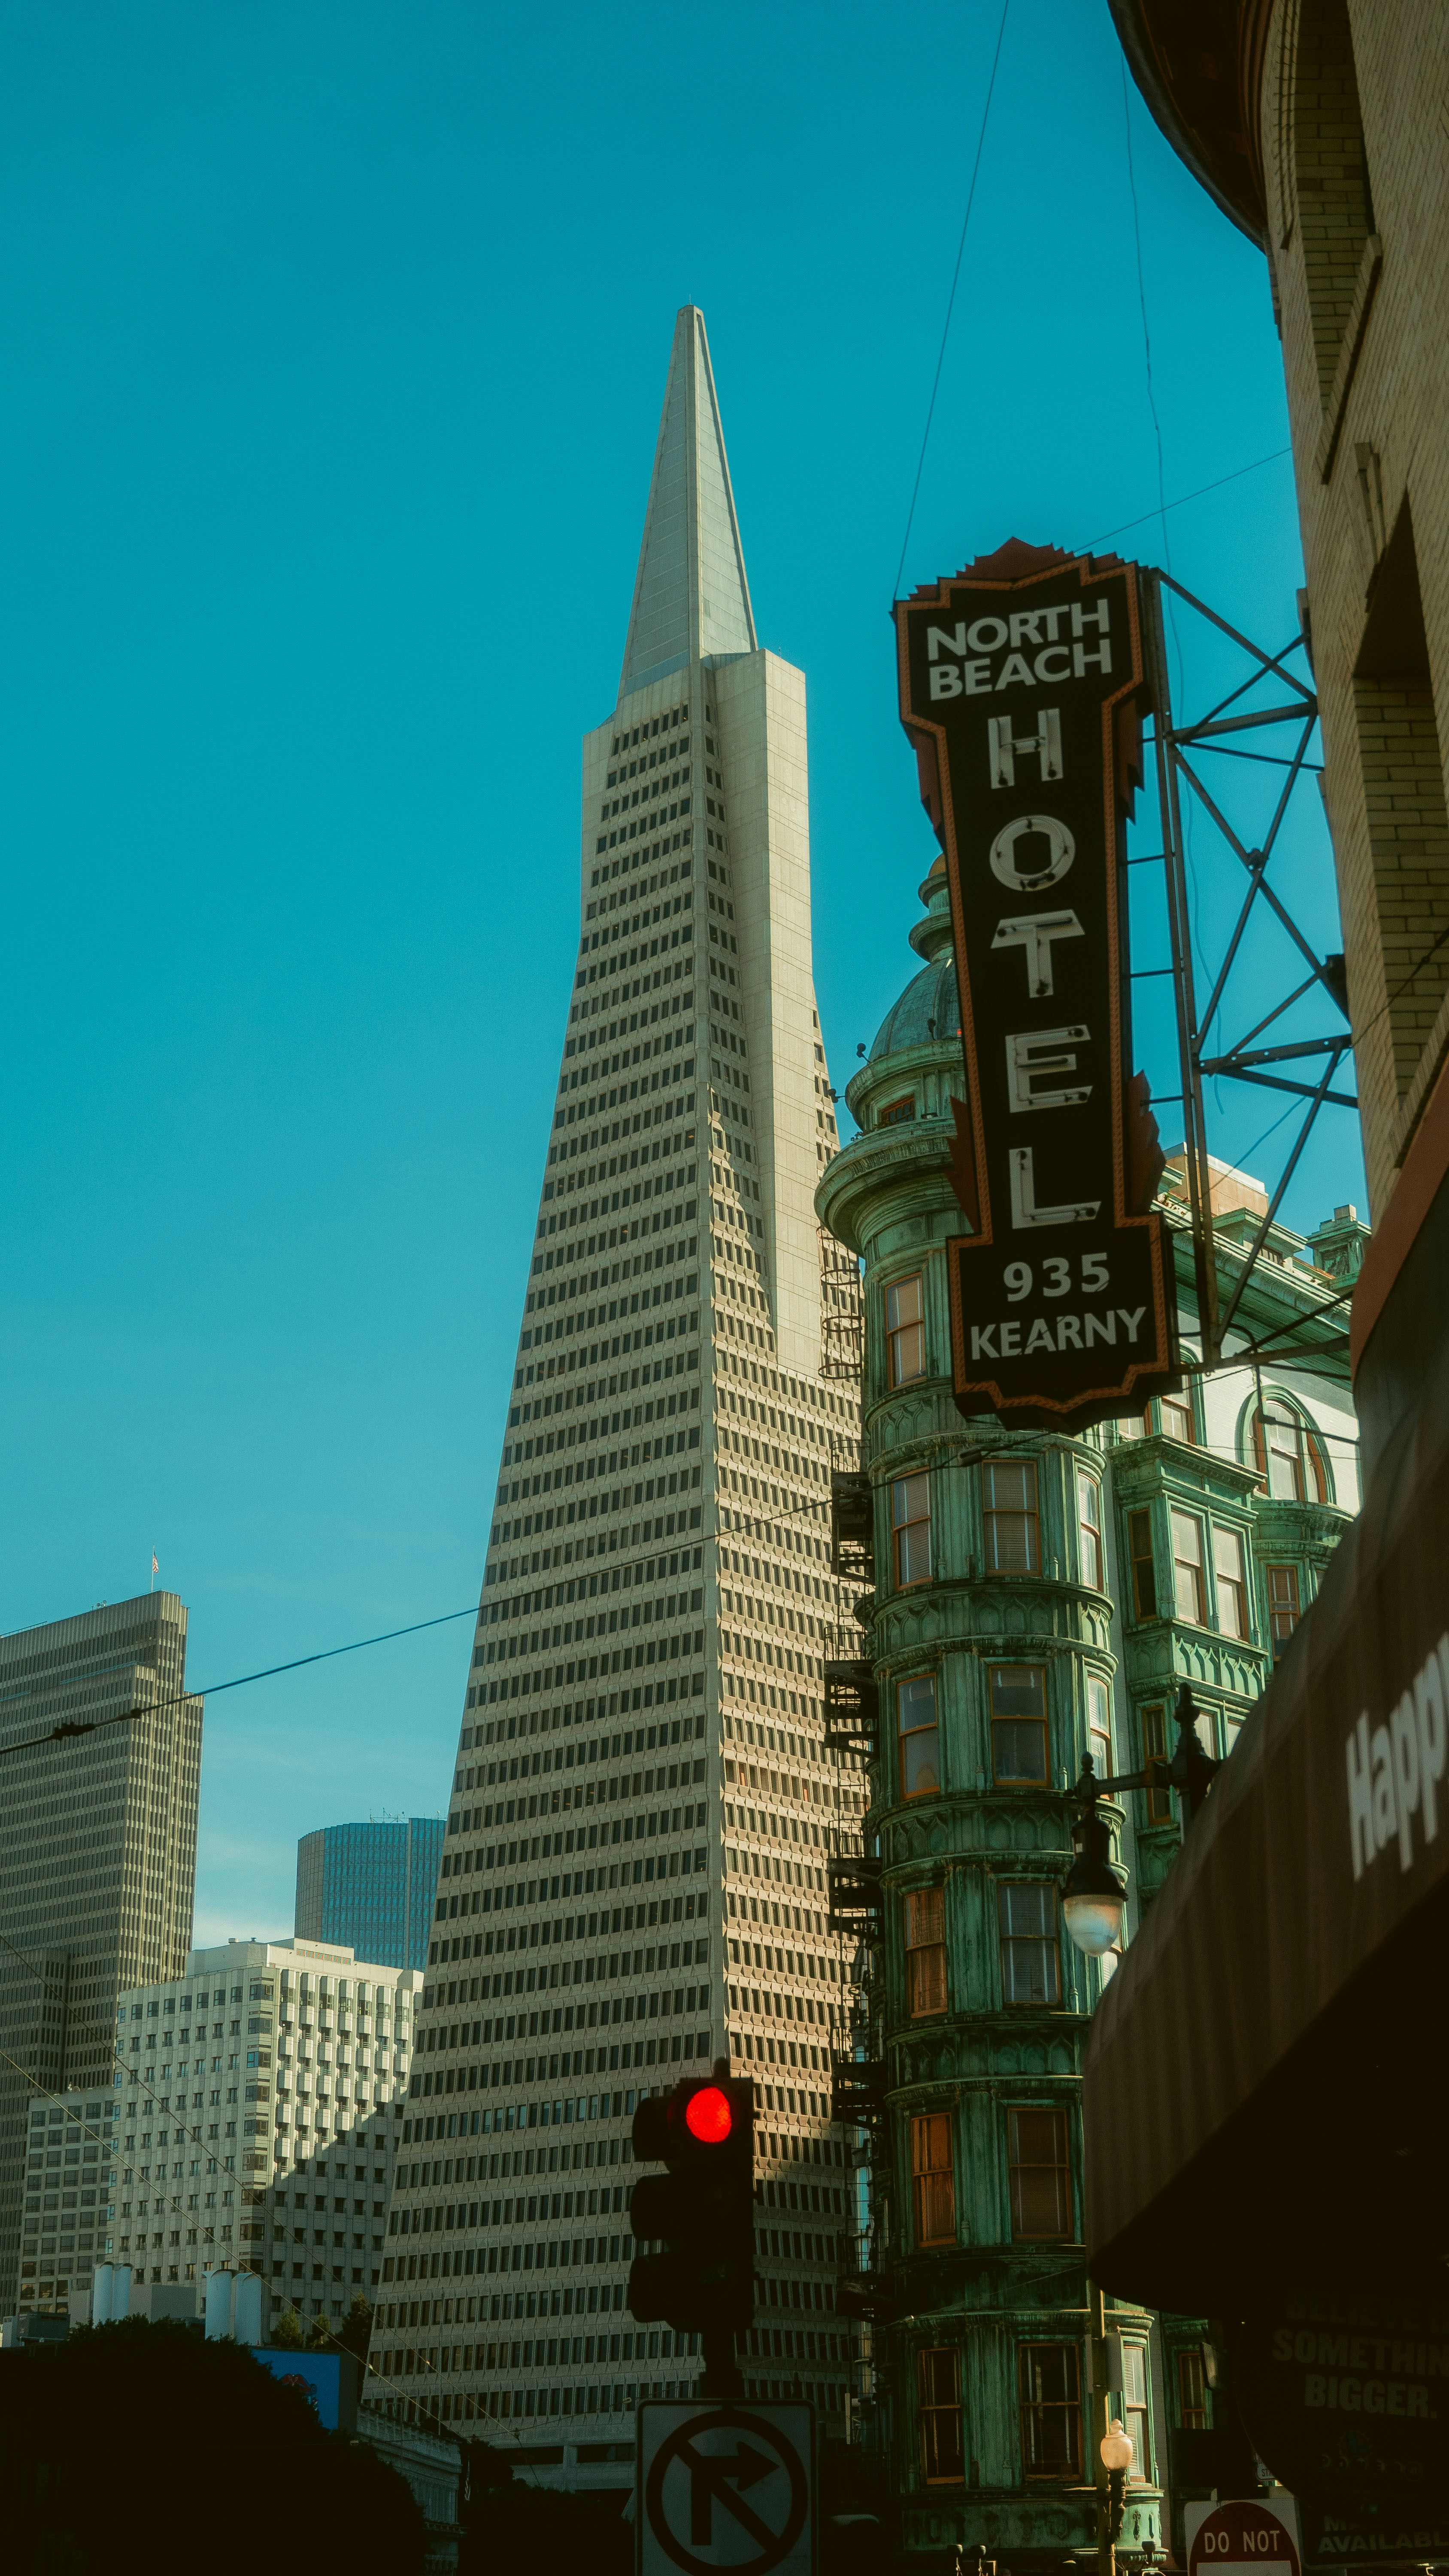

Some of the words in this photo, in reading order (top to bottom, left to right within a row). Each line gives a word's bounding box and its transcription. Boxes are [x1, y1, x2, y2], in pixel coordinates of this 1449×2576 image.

[927, 598, 1111, 661] NORTH
[929, 638, 1113, 701] BEACH
[987, 708, 1102, 1230] HOTEL
[1003, 1252, 1110, 1302] 935
[970, 1306, 1147, 1360] KEARNY
[1305, 2373, 1438, 2420] BIGGER.
[1204, 2531, 1229, 2553] DO
[1243, 2530, 1280, 2552] NOT
